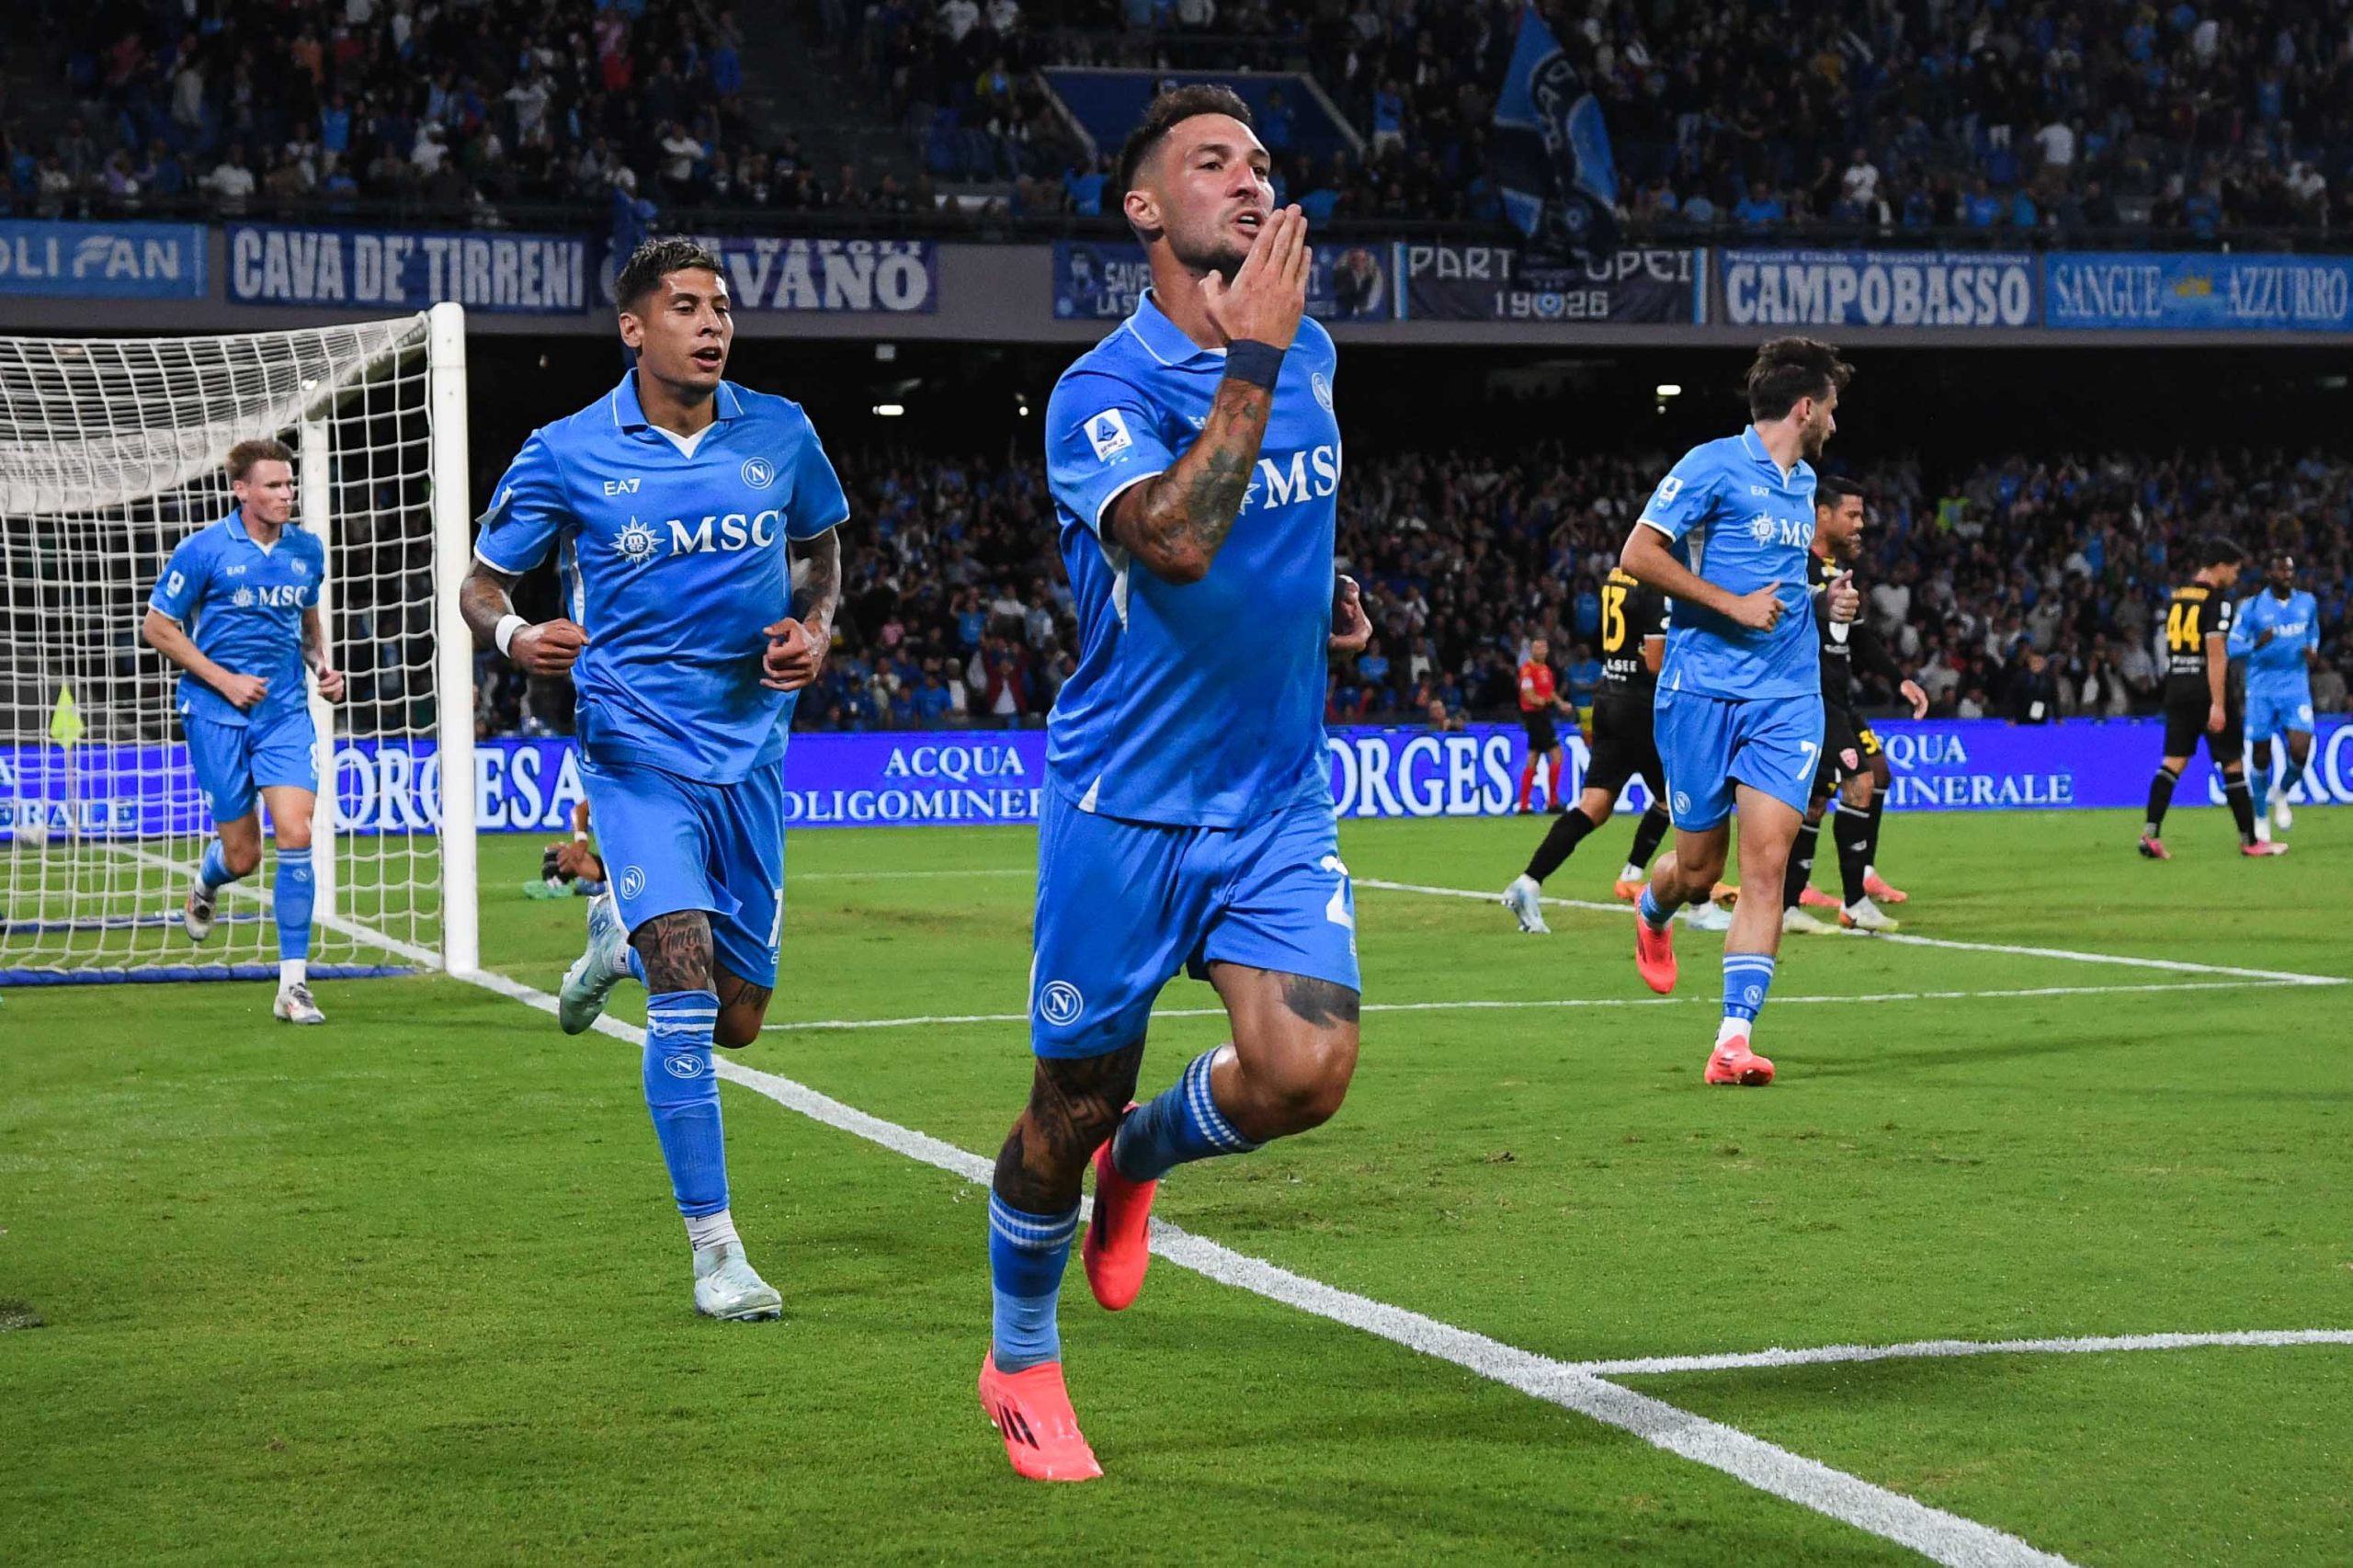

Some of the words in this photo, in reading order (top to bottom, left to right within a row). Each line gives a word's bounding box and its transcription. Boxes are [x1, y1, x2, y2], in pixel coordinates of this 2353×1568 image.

[73, 235, 178, 278] FAN
[233, 228, 344, 300] CAVA
[423, 237, 583, 307] TIRRENI
[1728, 265, 2029, 325] CAMPOBASSO
[2055, 265, 2161, 317] SANGUE
[2229, 266, 2347, 319] AZZURRO
[603, 478, 641, 496] EA7
[1257, 444, 1342, 510] MS
[666, 510, 780, 556] MSC
[1779, 518, 1814, 548] MS
[258, 585, 310, 608] MSC
[1602, 585, 1627, 653] 13
[2166, 602, 2201, 653] 44
[883, 745, 1025, 782] ACQUA
[1797, 741, 1823, 781] 7
[1884, 774, 2074, 805] INERALE
